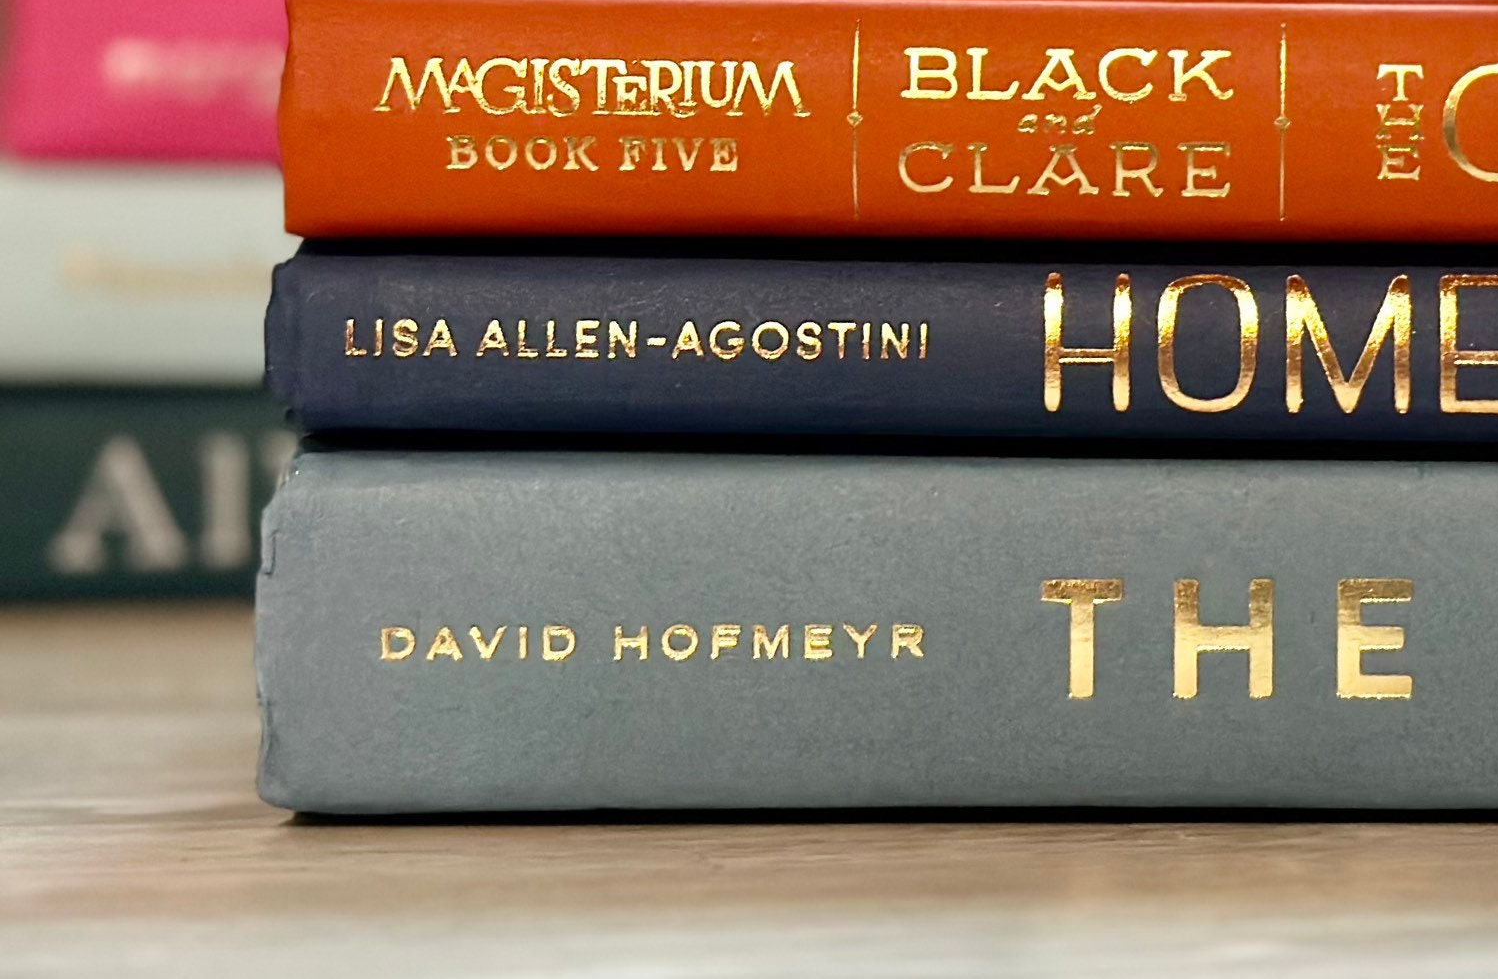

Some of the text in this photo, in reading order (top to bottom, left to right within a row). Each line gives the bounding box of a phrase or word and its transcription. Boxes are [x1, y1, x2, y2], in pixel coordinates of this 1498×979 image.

[374, 57, 811, 118] MAGISTERIUM
[901, 47, 1234, 102] BLACK
[1017, 104, 1102, 135] and
[1376, 64, 1424, 181] THE
[446, 135, 740, 172] BOOK FIVE
[898, 141, 1231, 198] CLARE
[344, 318, 929, 360] LISA ALLEN-AGOSTINI
[380, 623, 926, 662] DAVID HOFMEYR
[1040, 578, 1414, 699] THE
